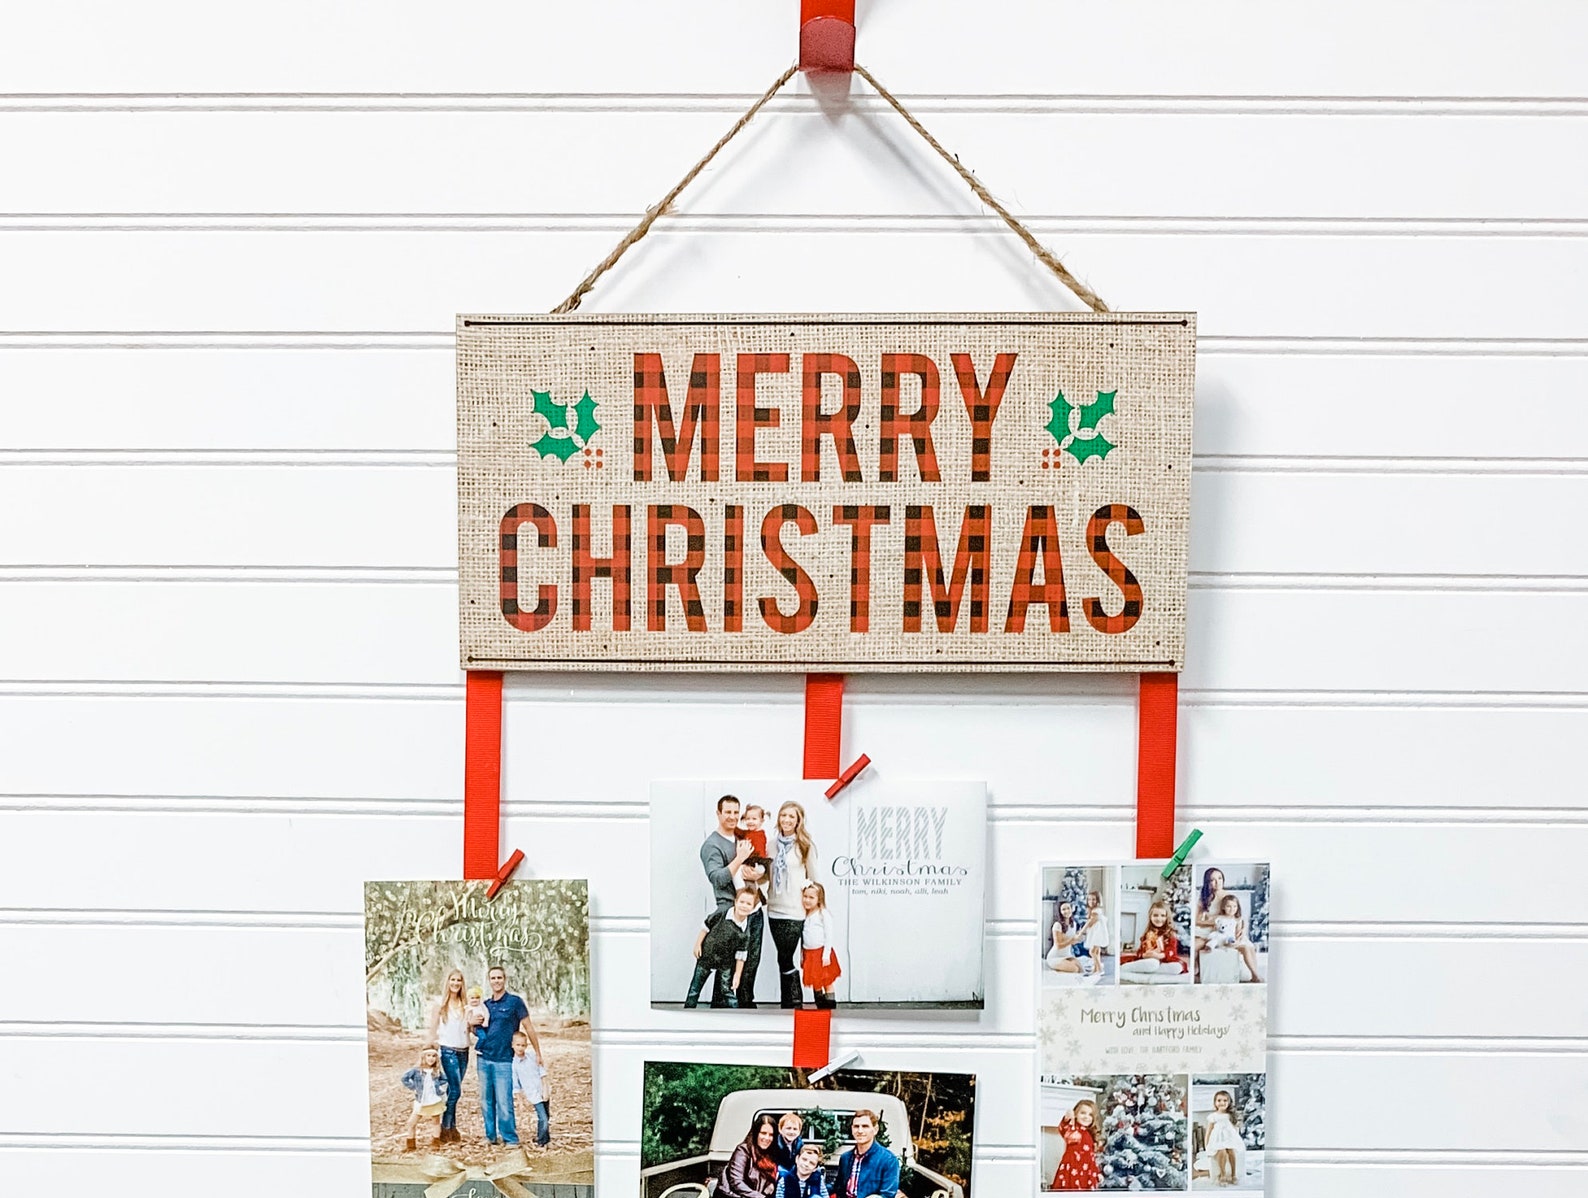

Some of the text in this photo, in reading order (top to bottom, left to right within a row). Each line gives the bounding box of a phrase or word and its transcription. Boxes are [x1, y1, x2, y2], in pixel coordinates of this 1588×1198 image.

[632, 352, 1020, 483] MERRY
[499, 502, 1146, 635] CHRISTMAS
[857, 807, 948, 860] MERRY
[832, 856, 968, 877] Christmas
[838, 879, 962, 887] THE WILKINSON FAMILY
[415, 905, 543, 956] Christmas
[449, 886, 520, 934] Merry
[1081, 1006, 1201, 1029] Merry Christmas
[1132, 1025, 1151, 1036] and
[1154, 1024, 1185, 1039] Happy
